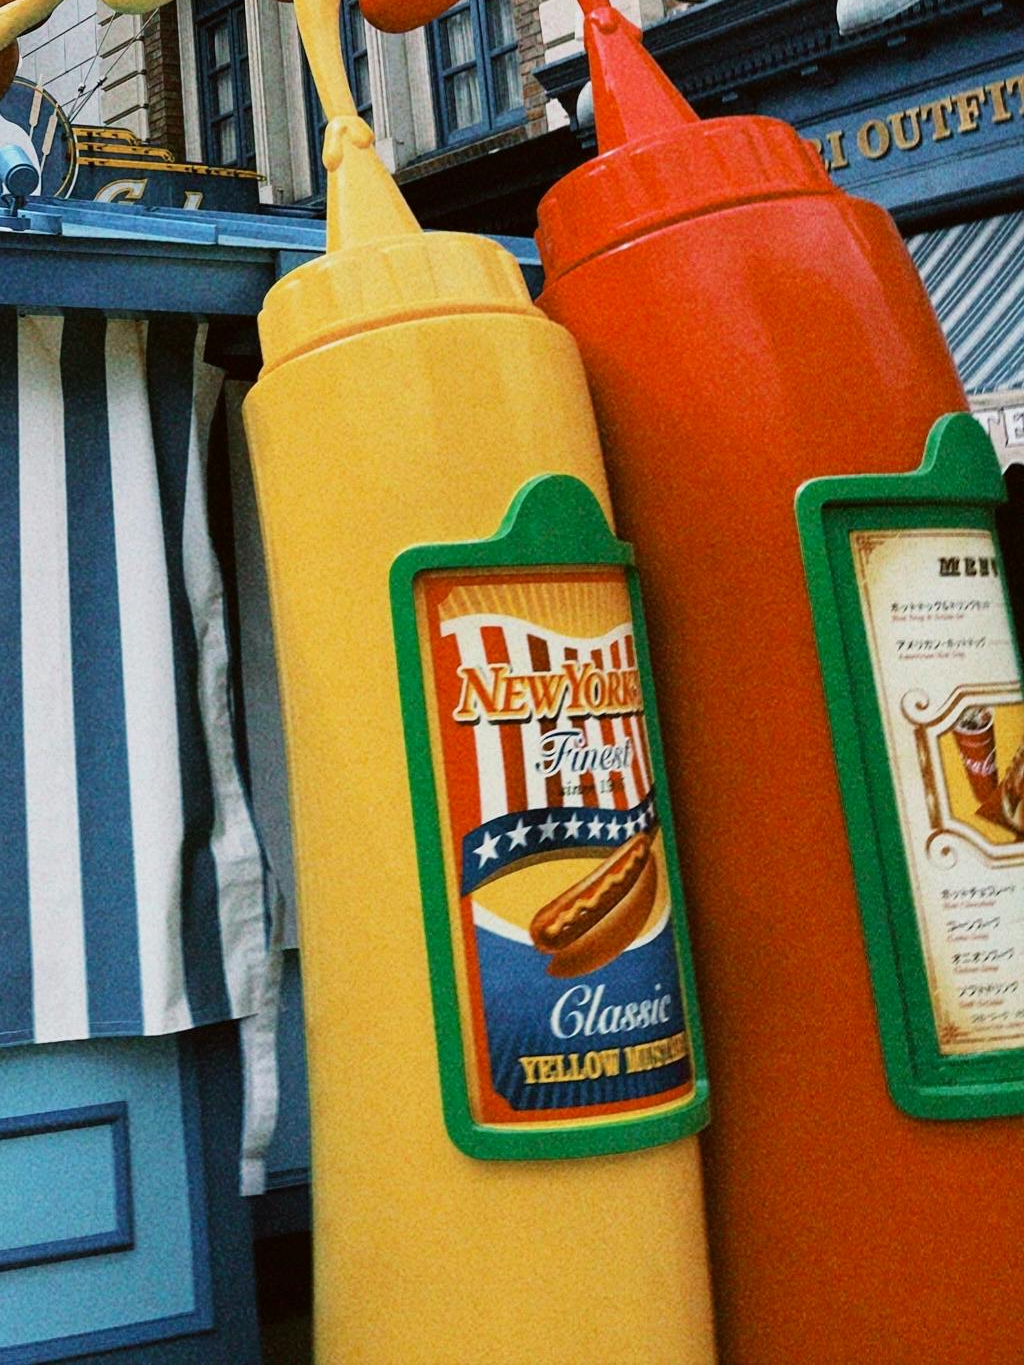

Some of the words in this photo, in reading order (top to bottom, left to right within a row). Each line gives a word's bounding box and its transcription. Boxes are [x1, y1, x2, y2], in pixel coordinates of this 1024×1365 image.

[535, 731, 631, 773] Finest
[550, 983, 672, 1039] Classic
[518, 1049, 621, 1084] YELLOW
